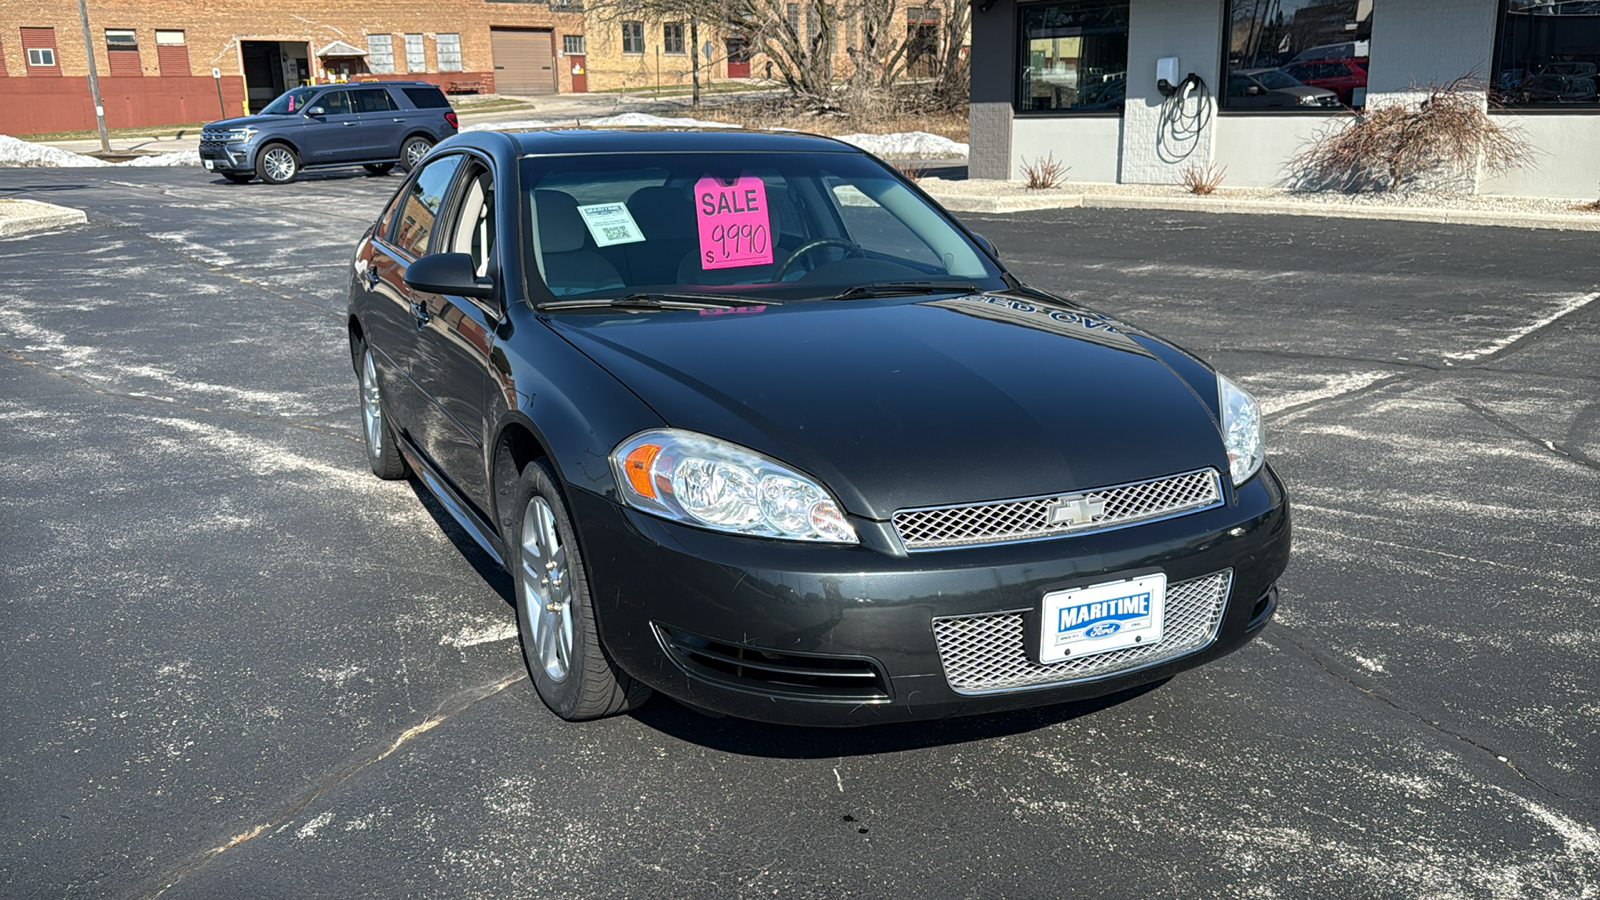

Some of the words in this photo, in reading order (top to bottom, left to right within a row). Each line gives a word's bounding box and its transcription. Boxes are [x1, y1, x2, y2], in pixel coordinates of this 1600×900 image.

[702, 189, 759, 216] SALE
[706, 250, 715, 264] $
[1060, 593, 1149, 631] MARITIME
[1090, 623, 1115, 637] Ford
